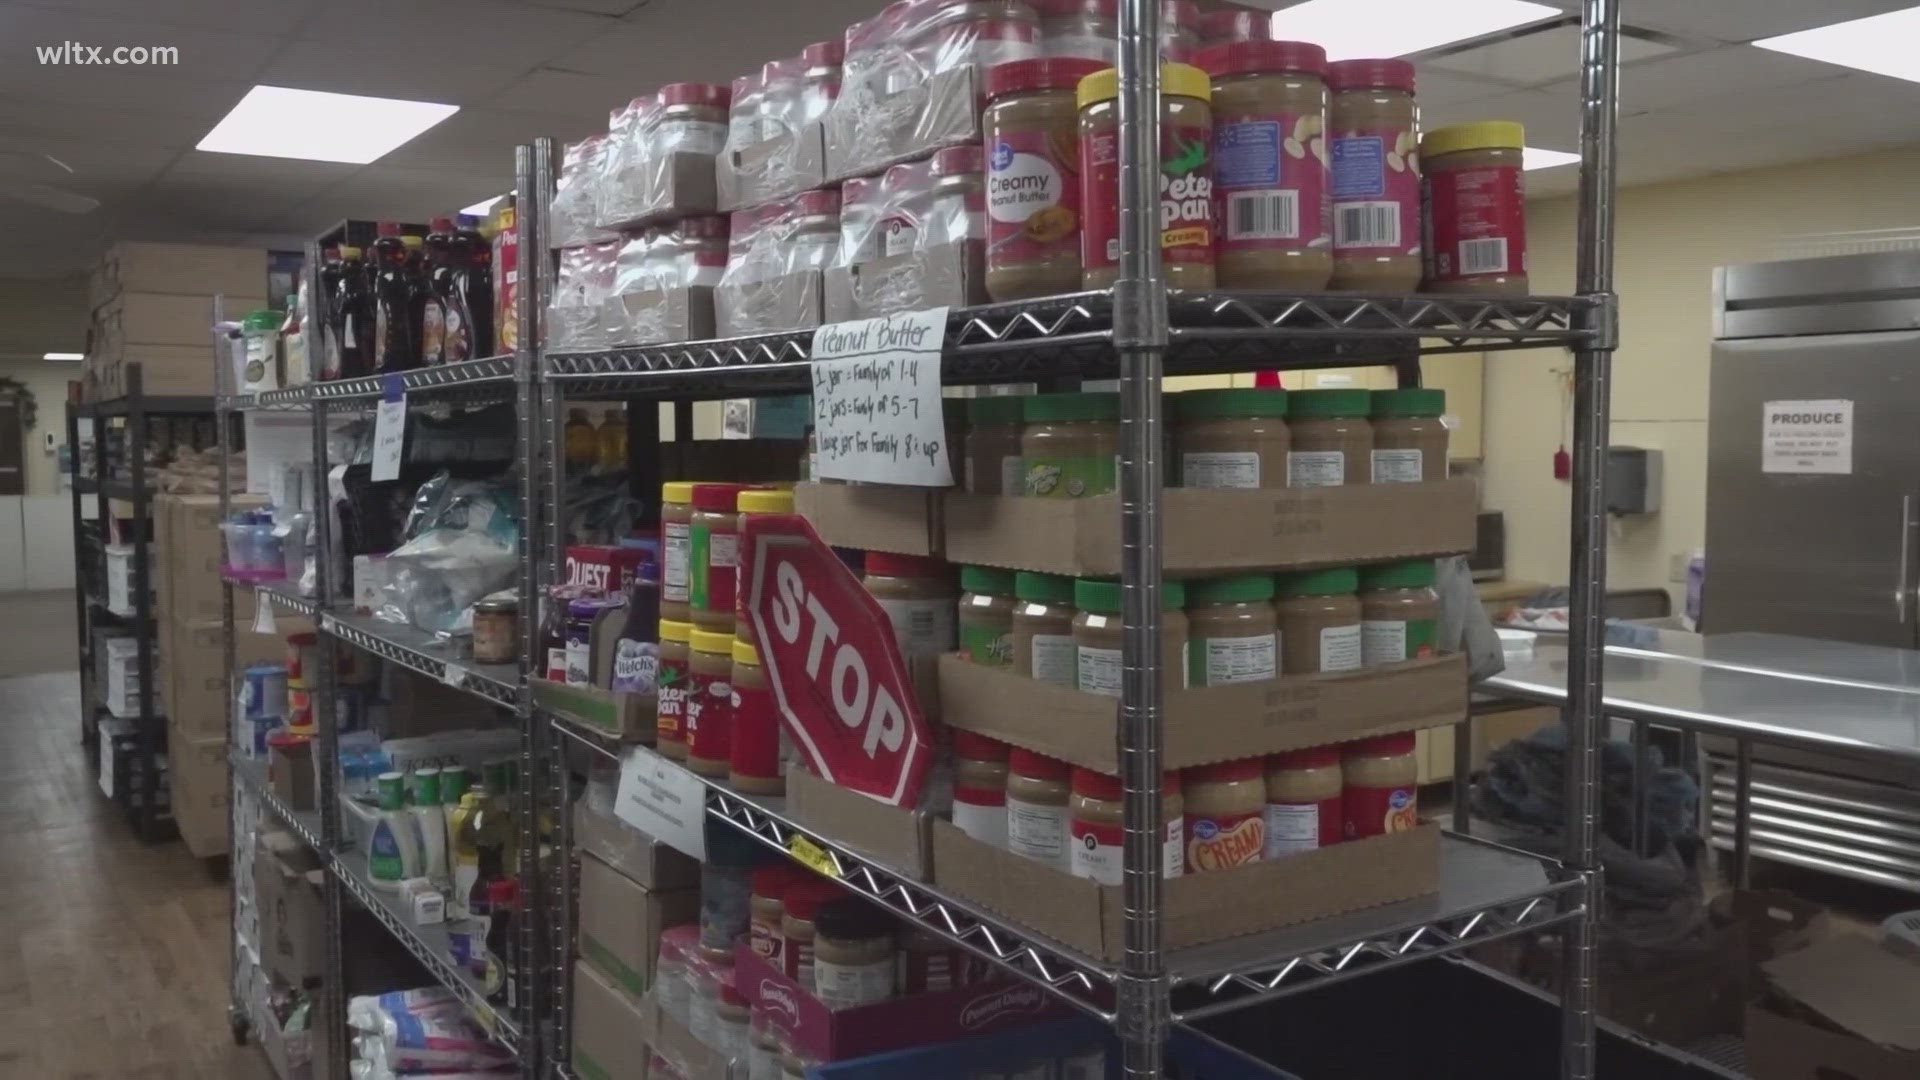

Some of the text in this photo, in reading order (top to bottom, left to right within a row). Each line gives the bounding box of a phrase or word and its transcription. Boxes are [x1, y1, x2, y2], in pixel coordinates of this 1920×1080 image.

[990, 174, 1050, 194] Creamy
[1019, 190, 1050, 203] Butter
[819, 316, 932, 353] Peanut Butter
[815, 365, 826, 387] 1
[826, 363, 843, 395] jar
[853, 359, 880, 391] Family
[818, 399, 826, 419] 2
[828, 398, 847, 427] jars
[1771, 412, 1843, 425] PRODUCE
[871, 431, 899, 463] Family
[904, 433, 913, 459] 8
[923, 440, 940, 467] up
[565, 556, 611, 590] QUEST
[617, 656, 655, 674] Welch's
[772, 559, 906, 760] STOP
[1195, 821, 1265, 873] CREAMY
